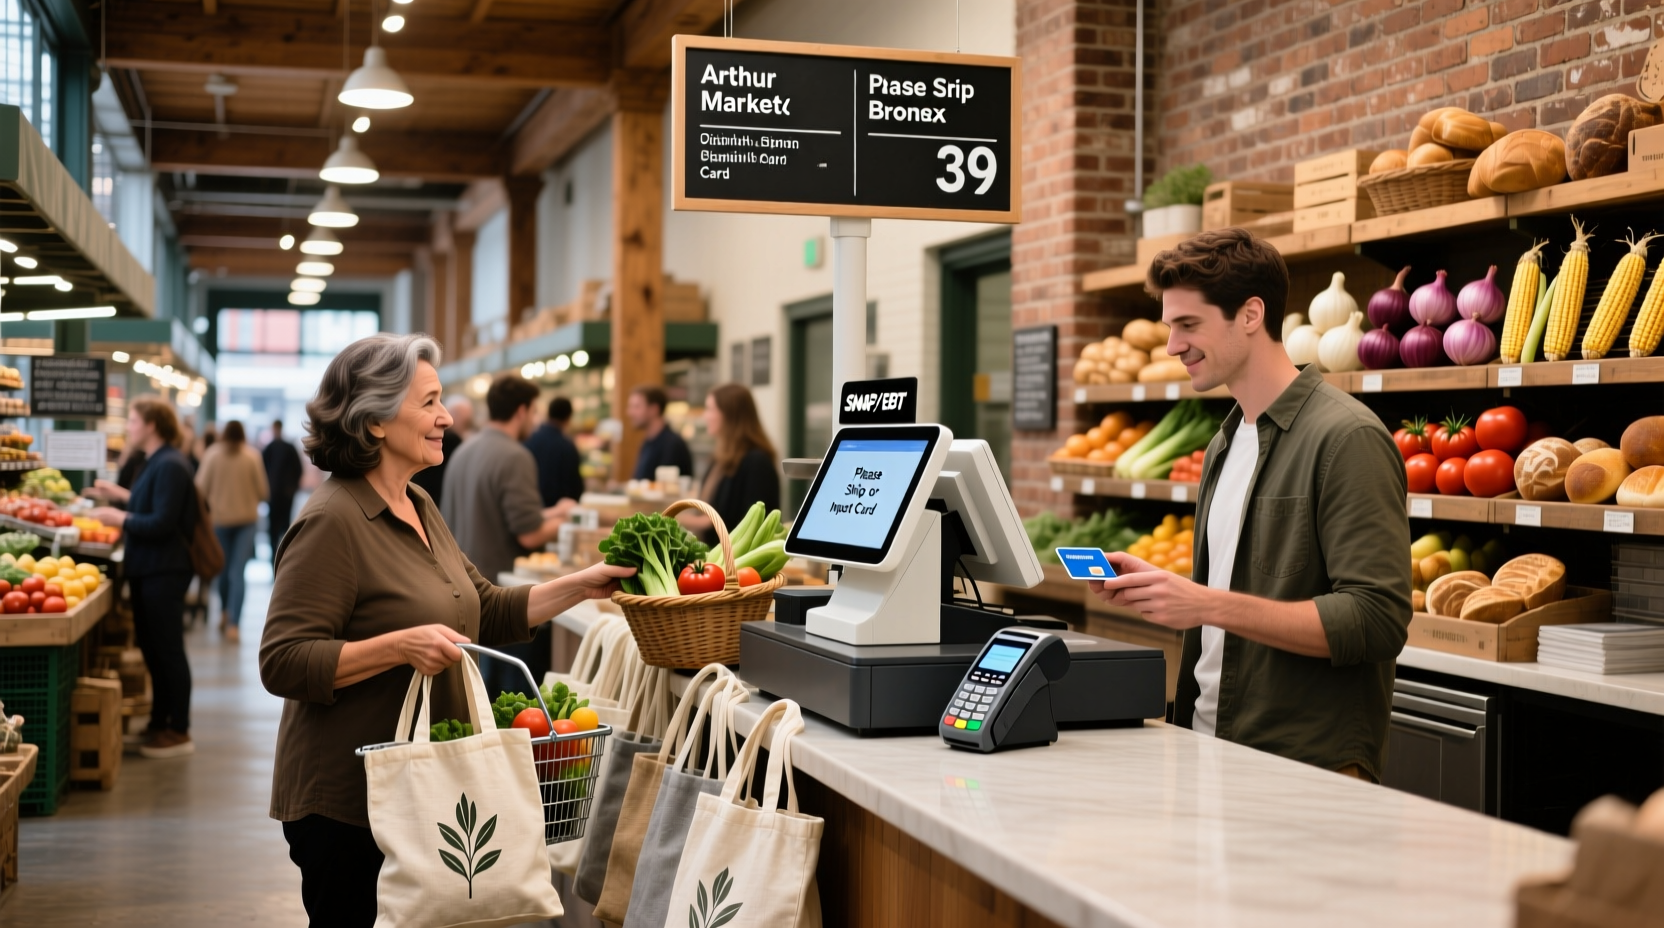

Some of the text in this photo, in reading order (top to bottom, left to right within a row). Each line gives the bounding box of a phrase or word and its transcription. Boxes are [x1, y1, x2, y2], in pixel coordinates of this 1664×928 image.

[701, 63, 777, 88] Arthur
[700, 165, 730, 179] Card
[936, 144, 998, 195] 39
